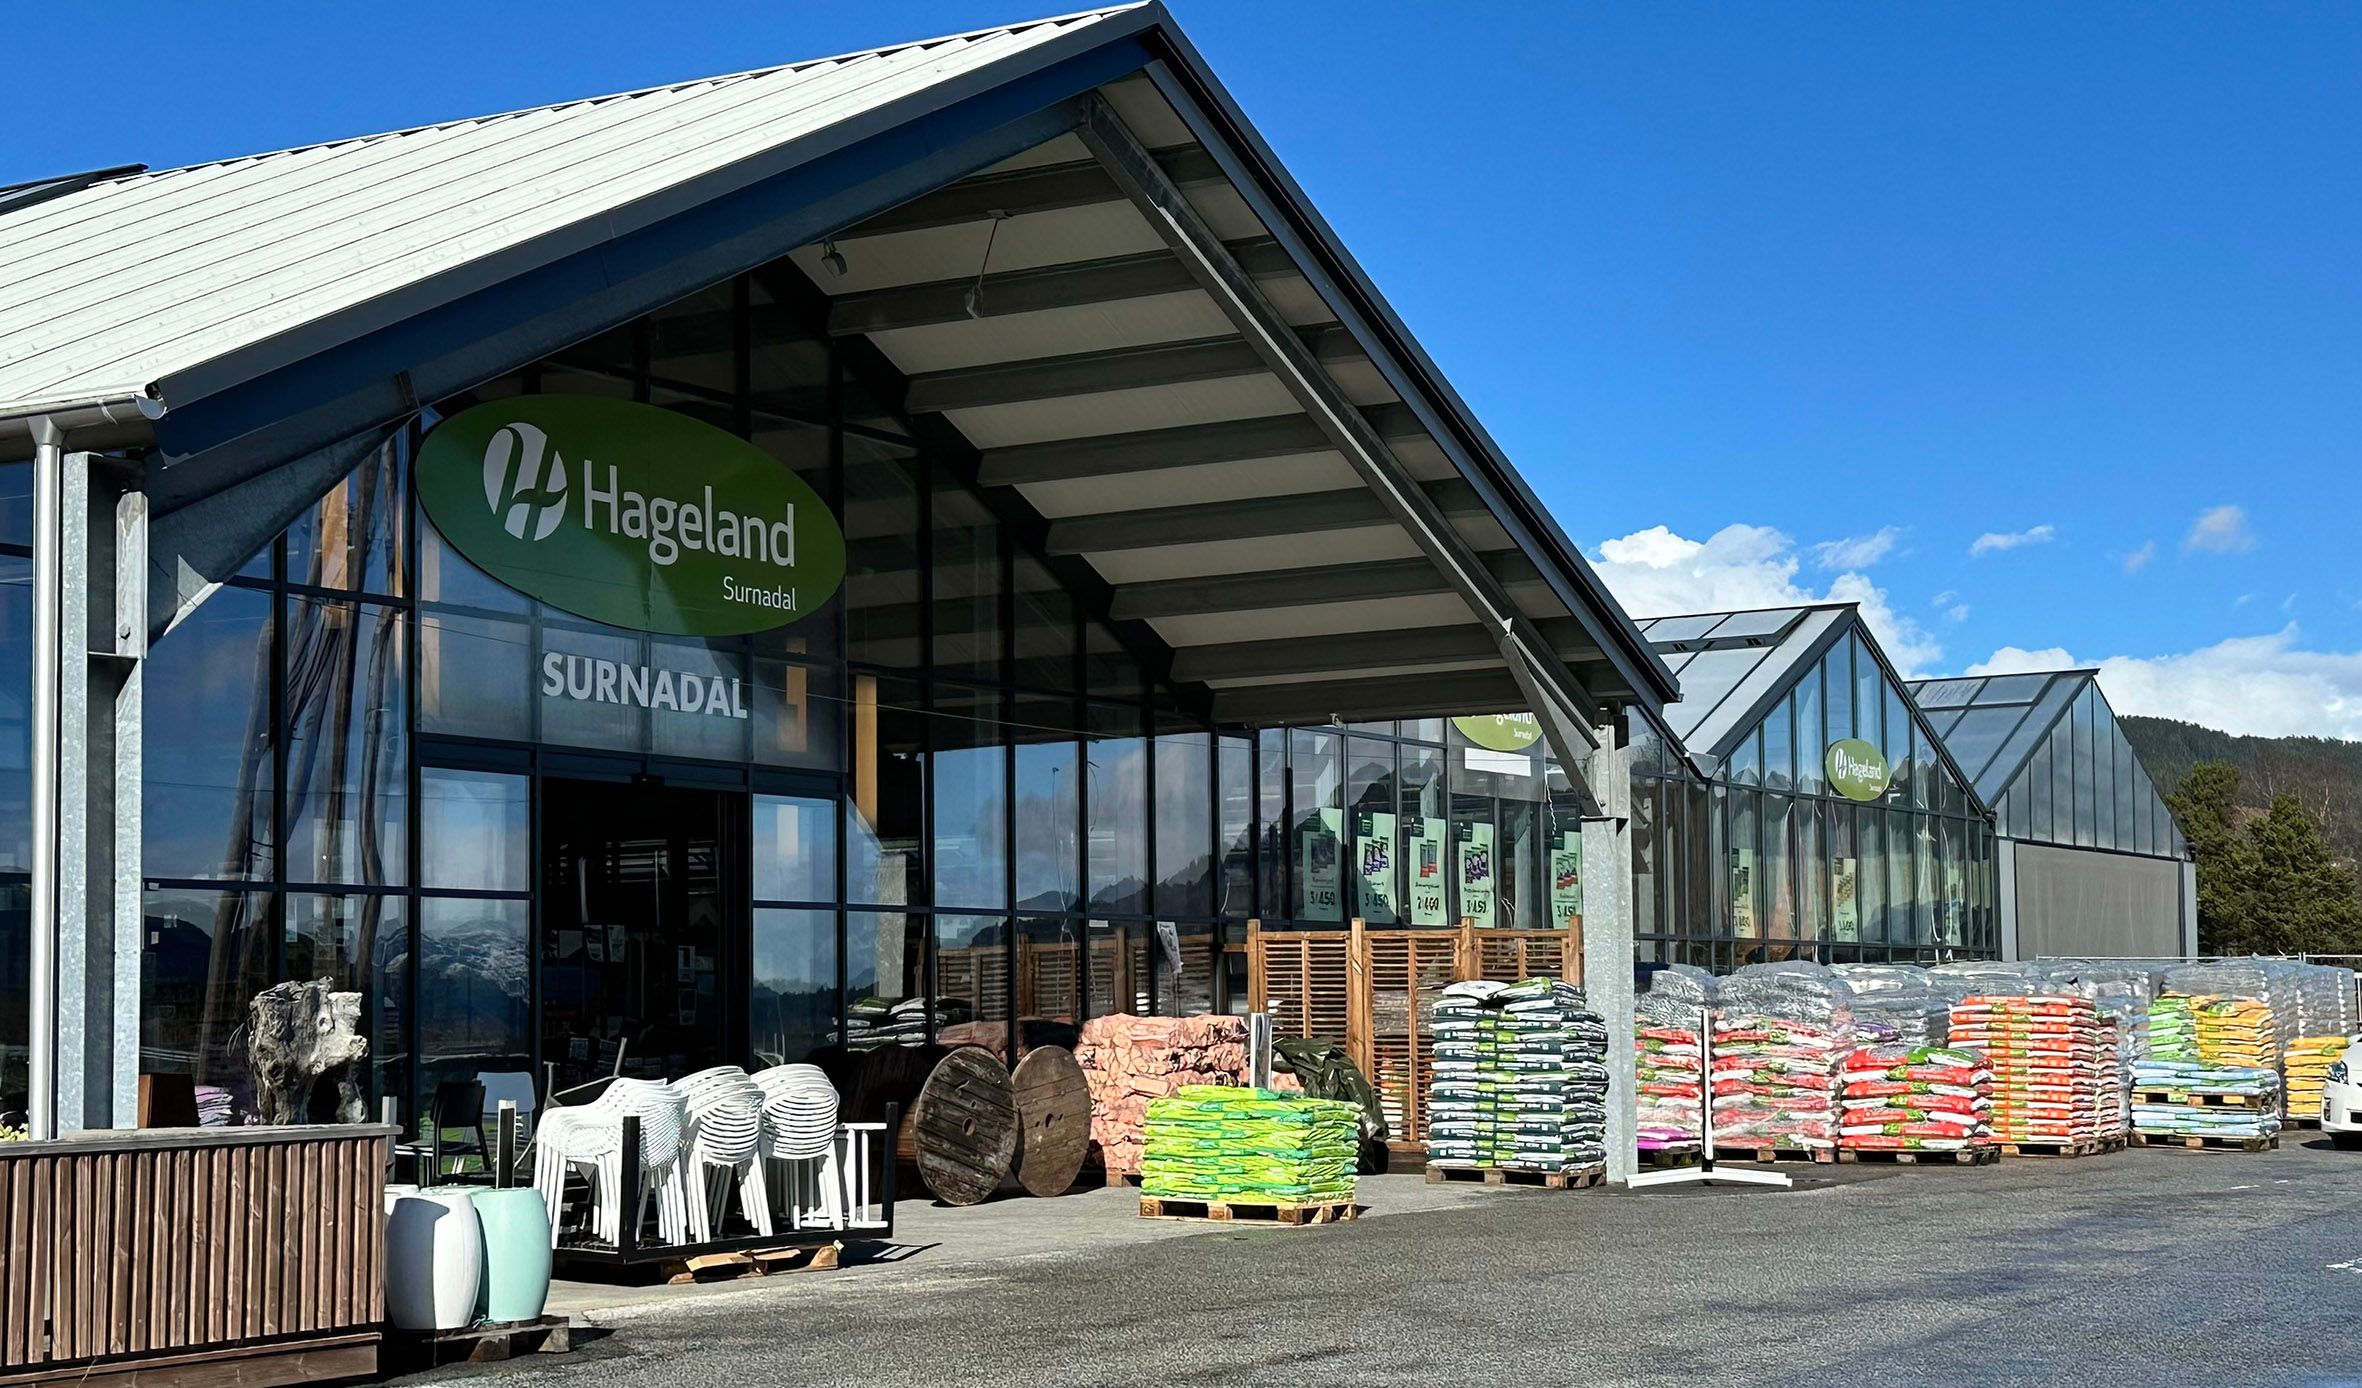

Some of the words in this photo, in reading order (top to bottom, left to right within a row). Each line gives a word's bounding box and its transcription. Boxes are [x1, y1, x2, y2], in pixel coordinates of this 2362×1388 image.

[583, 459, 795, 567] Hageland
[723, 576, 797, 611] Surnadal
[542, 651, 748, 720] SURNADAL
[1847, 755, 1882, 783] Hageland
